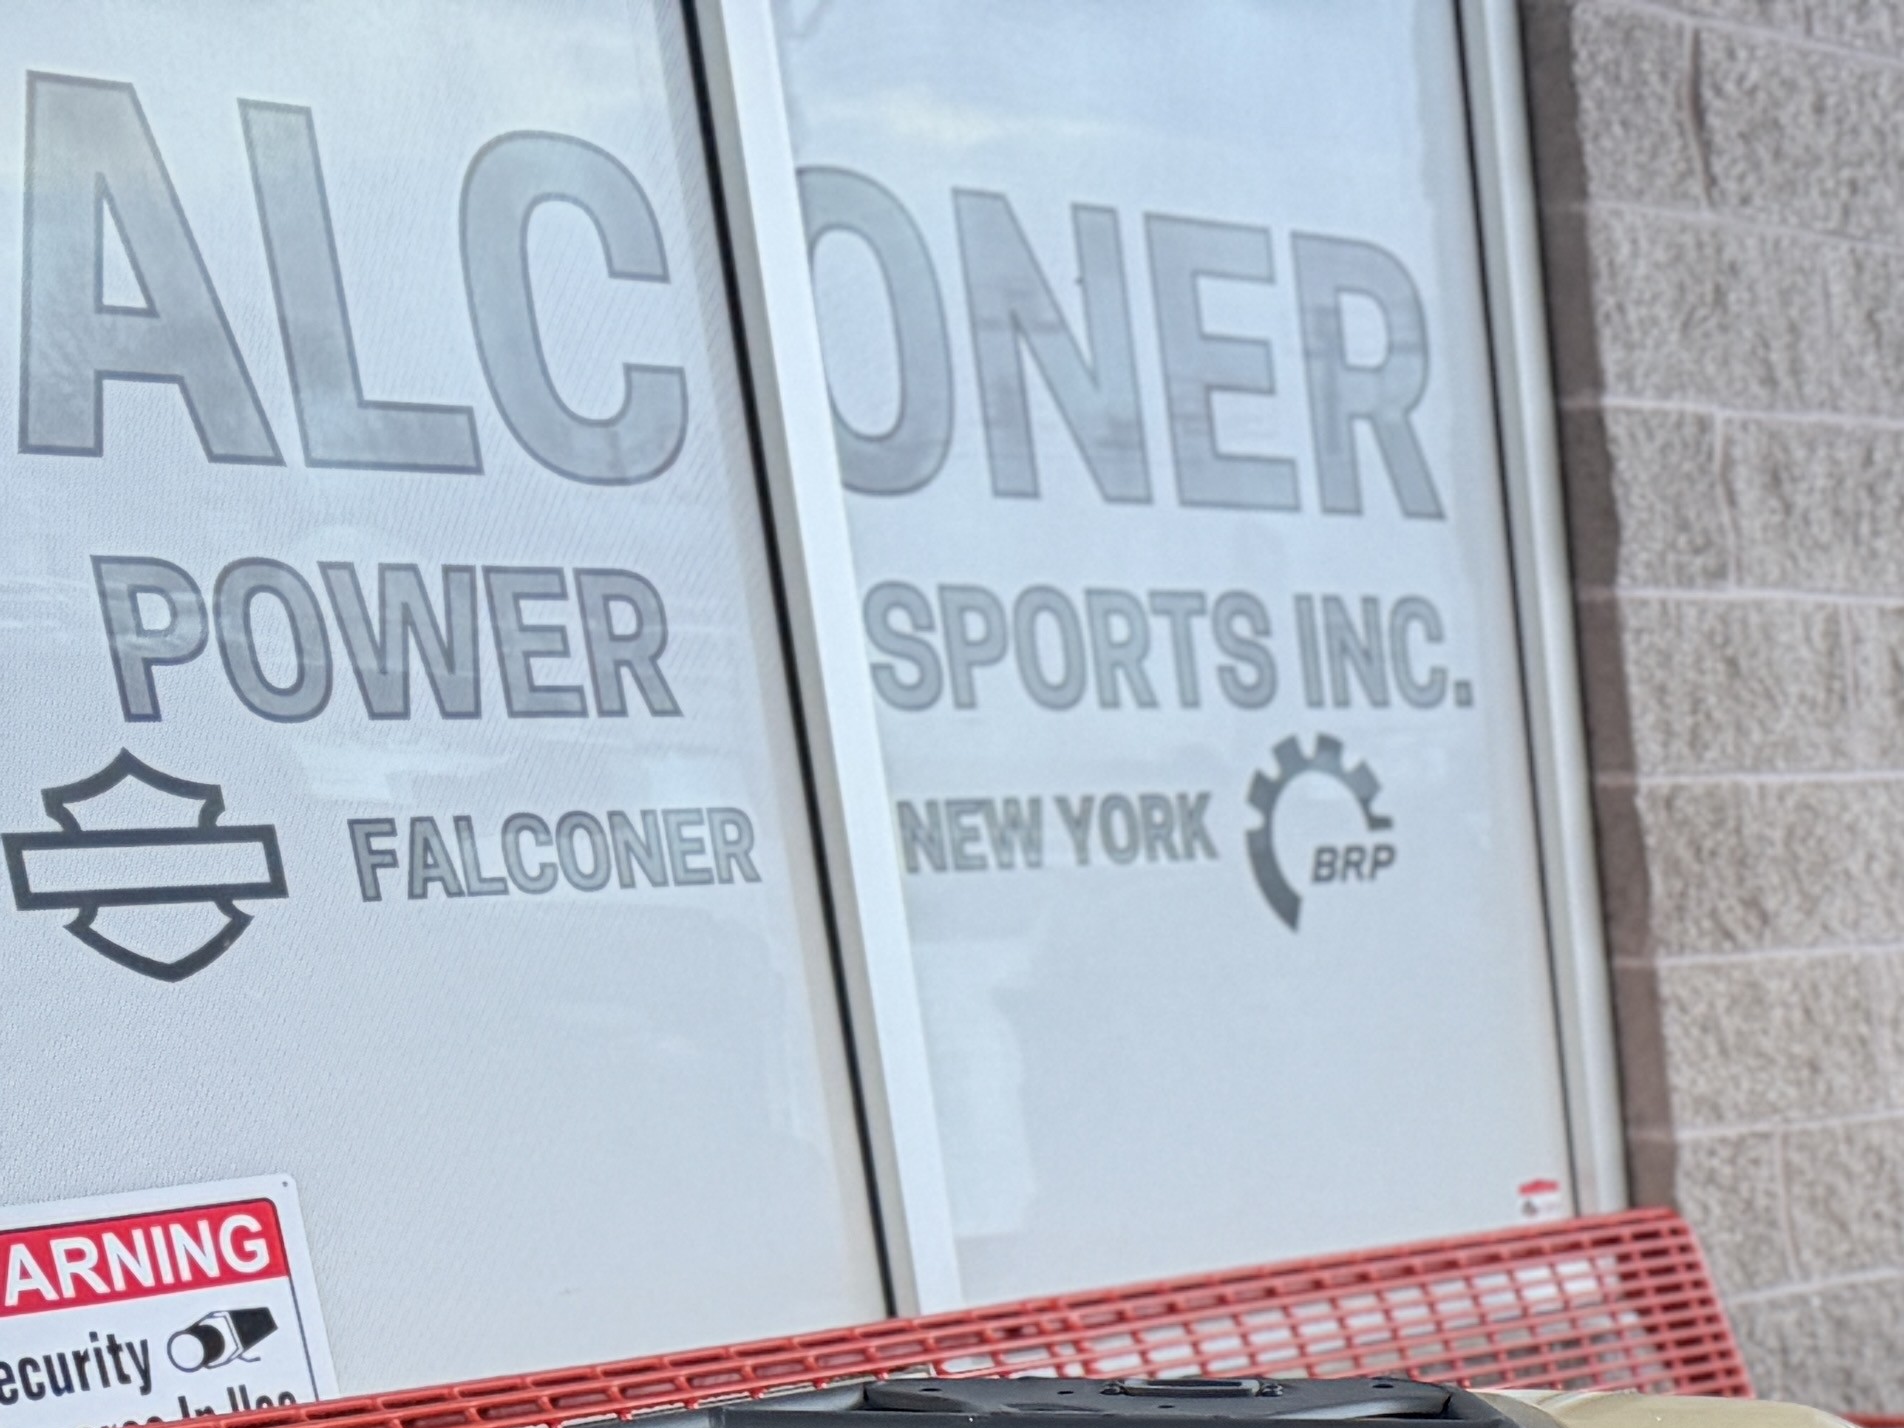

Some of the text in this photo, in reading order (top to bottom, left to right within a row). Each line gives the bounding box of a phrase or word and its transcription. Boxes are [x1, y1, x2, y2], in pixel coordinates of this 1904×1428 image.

[90, 554, 1476, 724] POWER SPORTS INC.
[348, 791, 1220, 903] FALCONER NEW YORK
[1312, 843, 1397, 884] BRP
